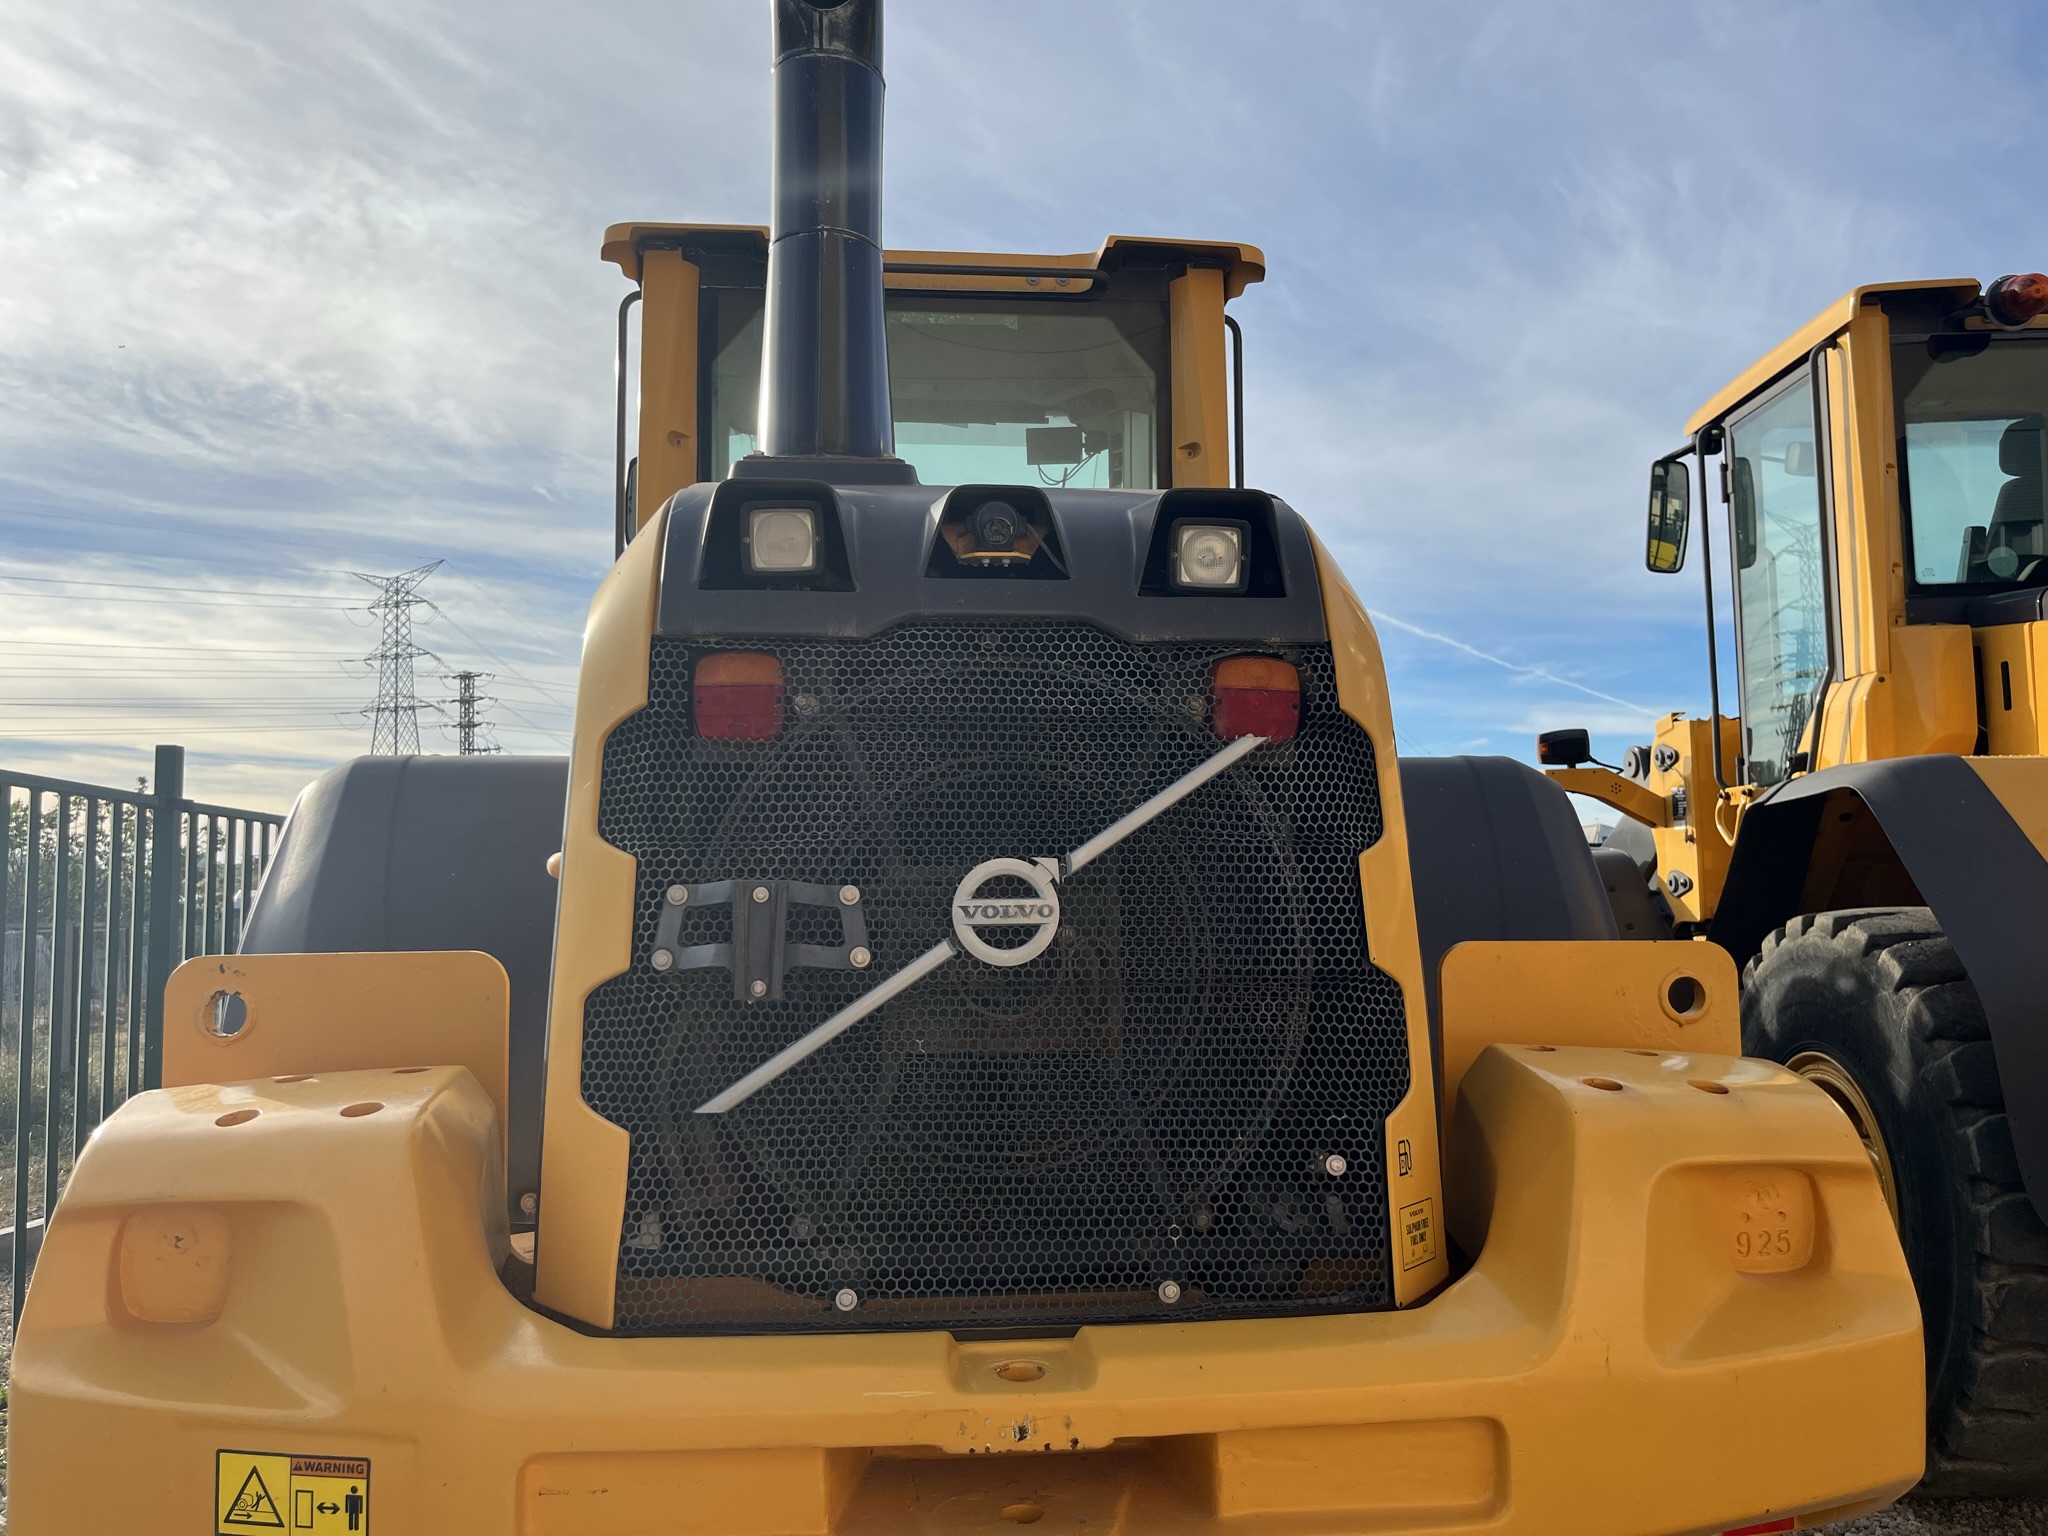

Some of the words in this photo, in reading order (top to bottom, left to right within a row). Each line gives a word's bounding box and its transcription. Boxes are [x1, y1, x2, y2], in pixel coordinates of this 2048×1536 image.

[957, 904, 1055, 919] VOLVO
[1409, 1208, 1424, 1217] VOLVO
[1736, 1229, 1791, 1258] 925
[304, 1461, 365, 1474] WARNING
